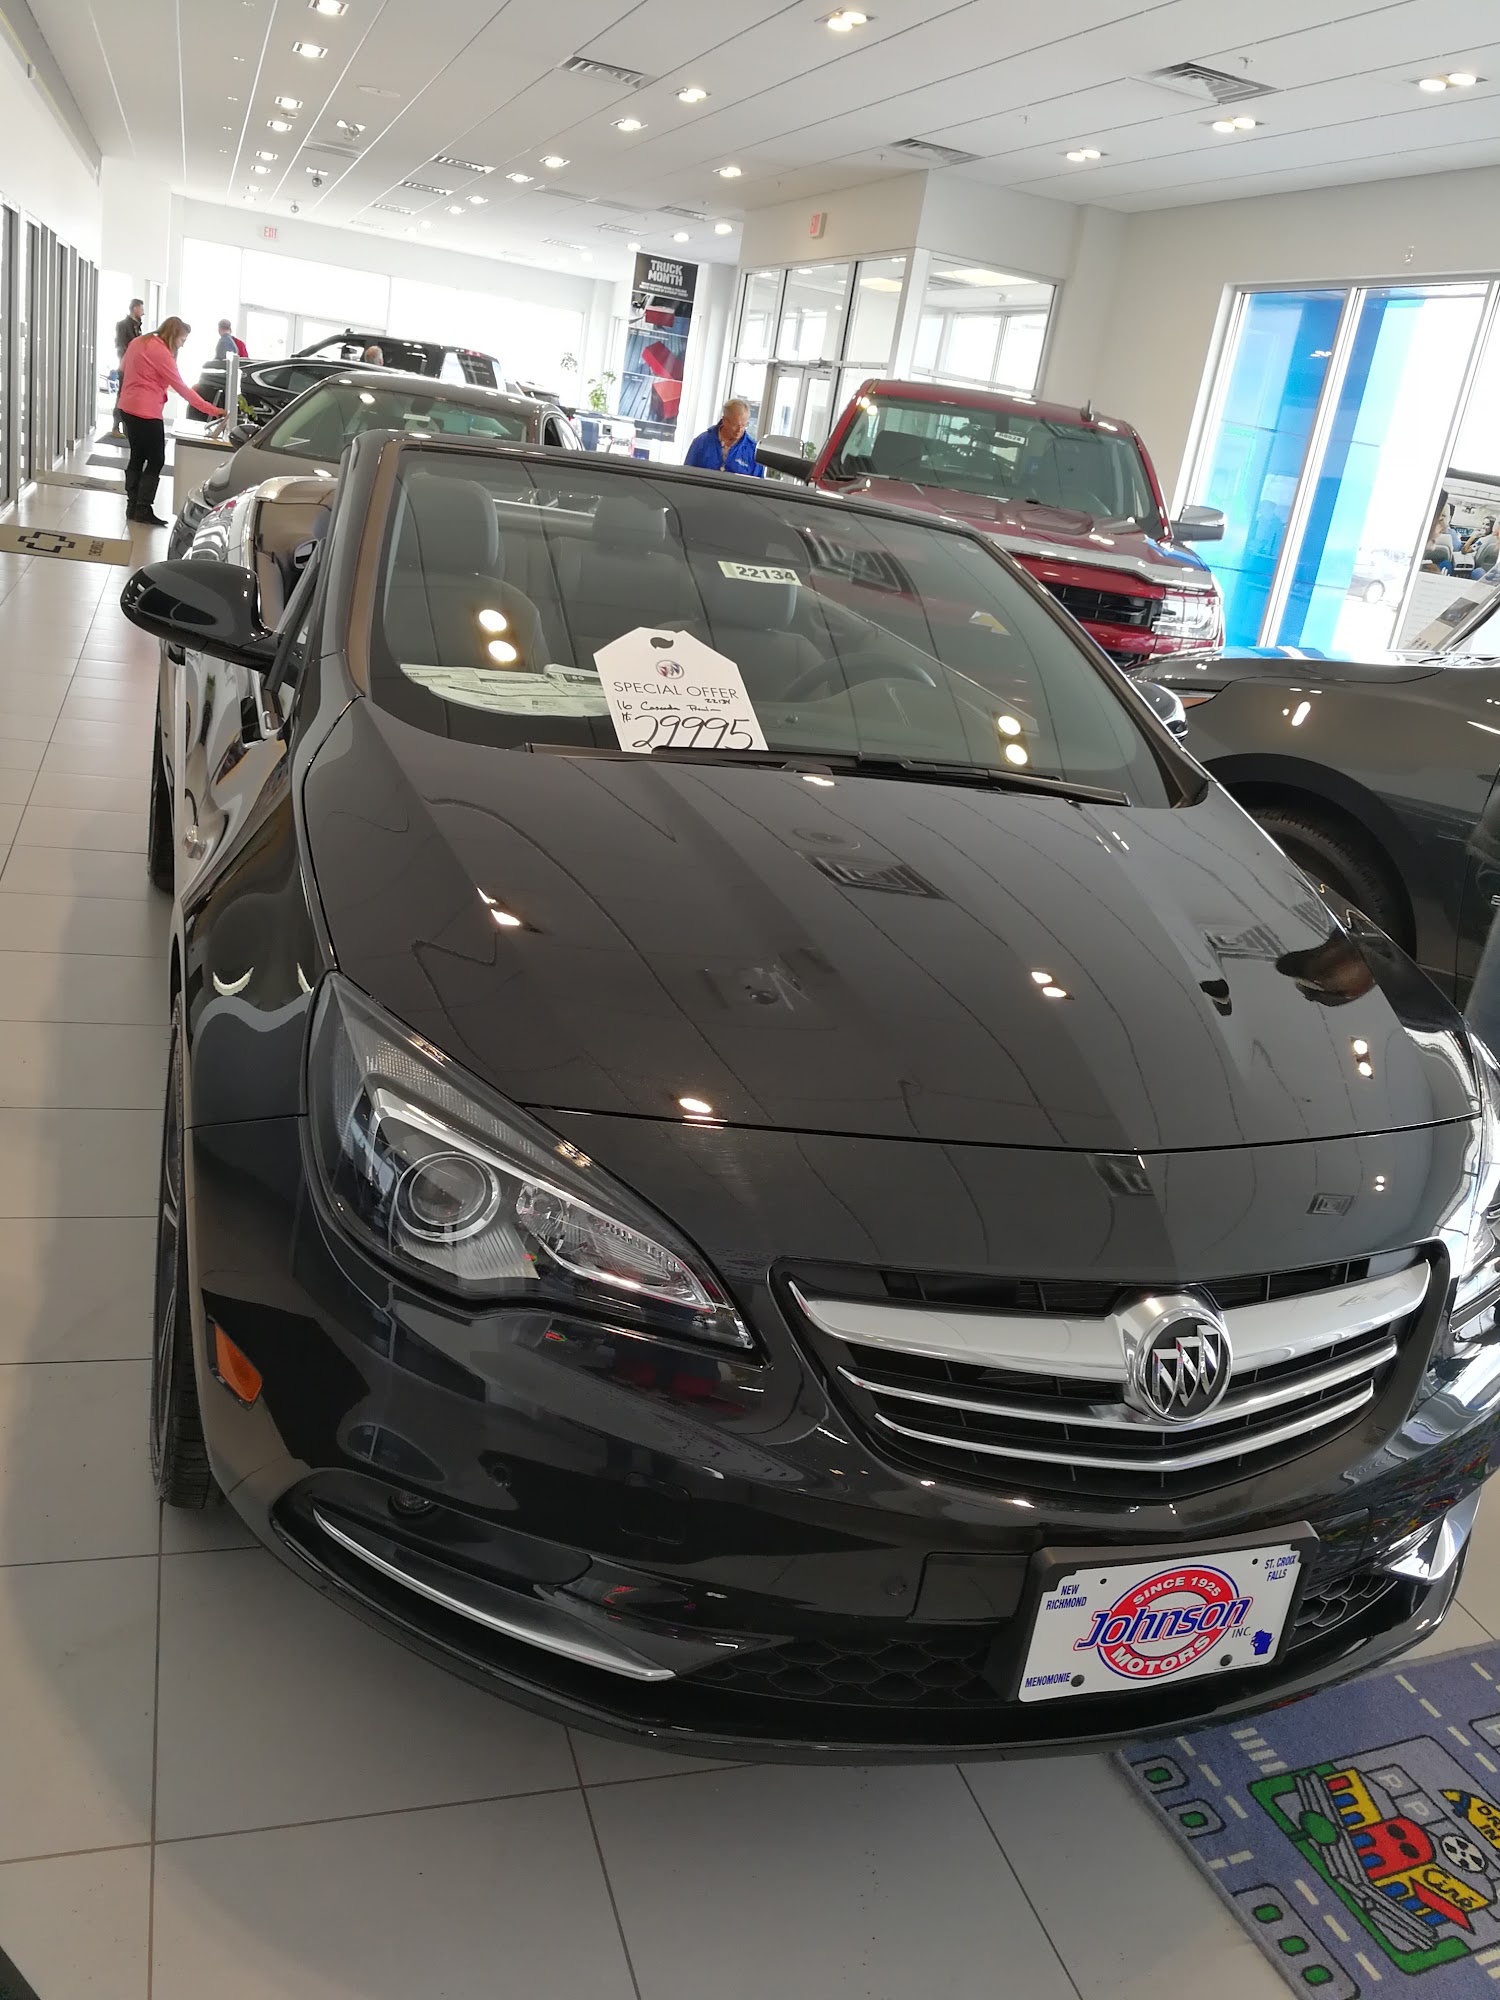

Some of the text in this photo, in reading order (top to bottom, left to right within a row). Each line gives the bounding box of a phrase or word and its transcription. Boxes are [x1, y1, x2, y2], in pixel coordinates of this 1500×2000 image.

[264, 226, 278, 239] EXIT
[650, 259, 683, 276] TRUCK
[648, 269, 683, 286] MONTH
[736, 565, 796, 582] 22134
[613, 681, 739, 699] SPECIAL OFFER
[616, 699, 633, 711] 16
[1264, 1554, 1297, 1570] ST. CROIX
[1266, 1568, 1288, 1582] FALLS
[1060, 1584, 1080, 1596] NEW
[1133, 1576, 1222, 1605] SINCE 1925
[1045, 1596, 1087, 1611] RICHMOND
[1074, 1597, 1253, 1650] Johnson
[1231, 1626, 1251, 1639] INC.
[1110, 1634, 1211, 1674] MOTORS
[1025, 1672, 1072, 1688] MENOMONIE
